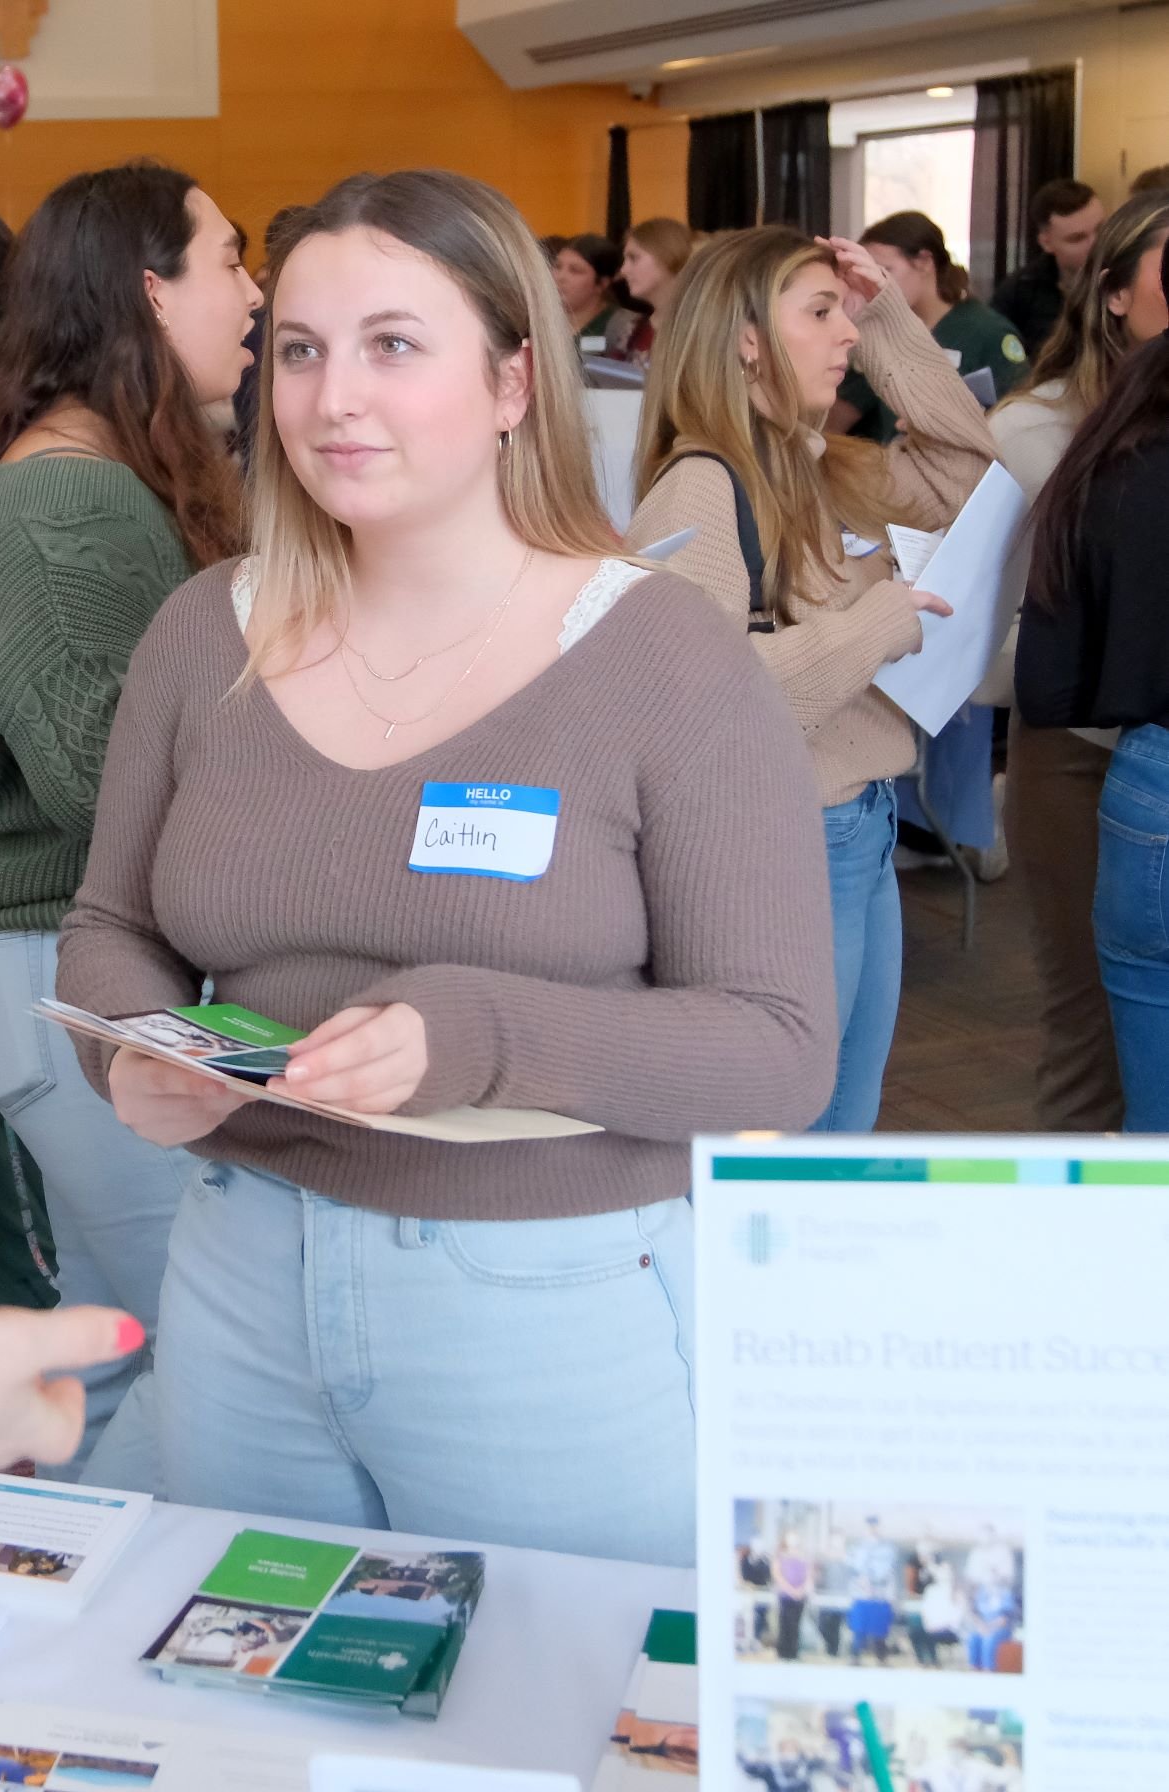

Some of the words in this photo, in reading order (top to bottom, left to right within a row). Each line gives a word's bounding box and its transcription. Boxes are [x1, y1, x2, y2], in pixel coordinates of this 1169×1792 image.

[466, 788, 512, 800] HELLO
[424, 817, 497, 851] Caitlin
[731, 1328, 872, 1369] Rehab
[881, 1331, 1034, 1372] Patient
